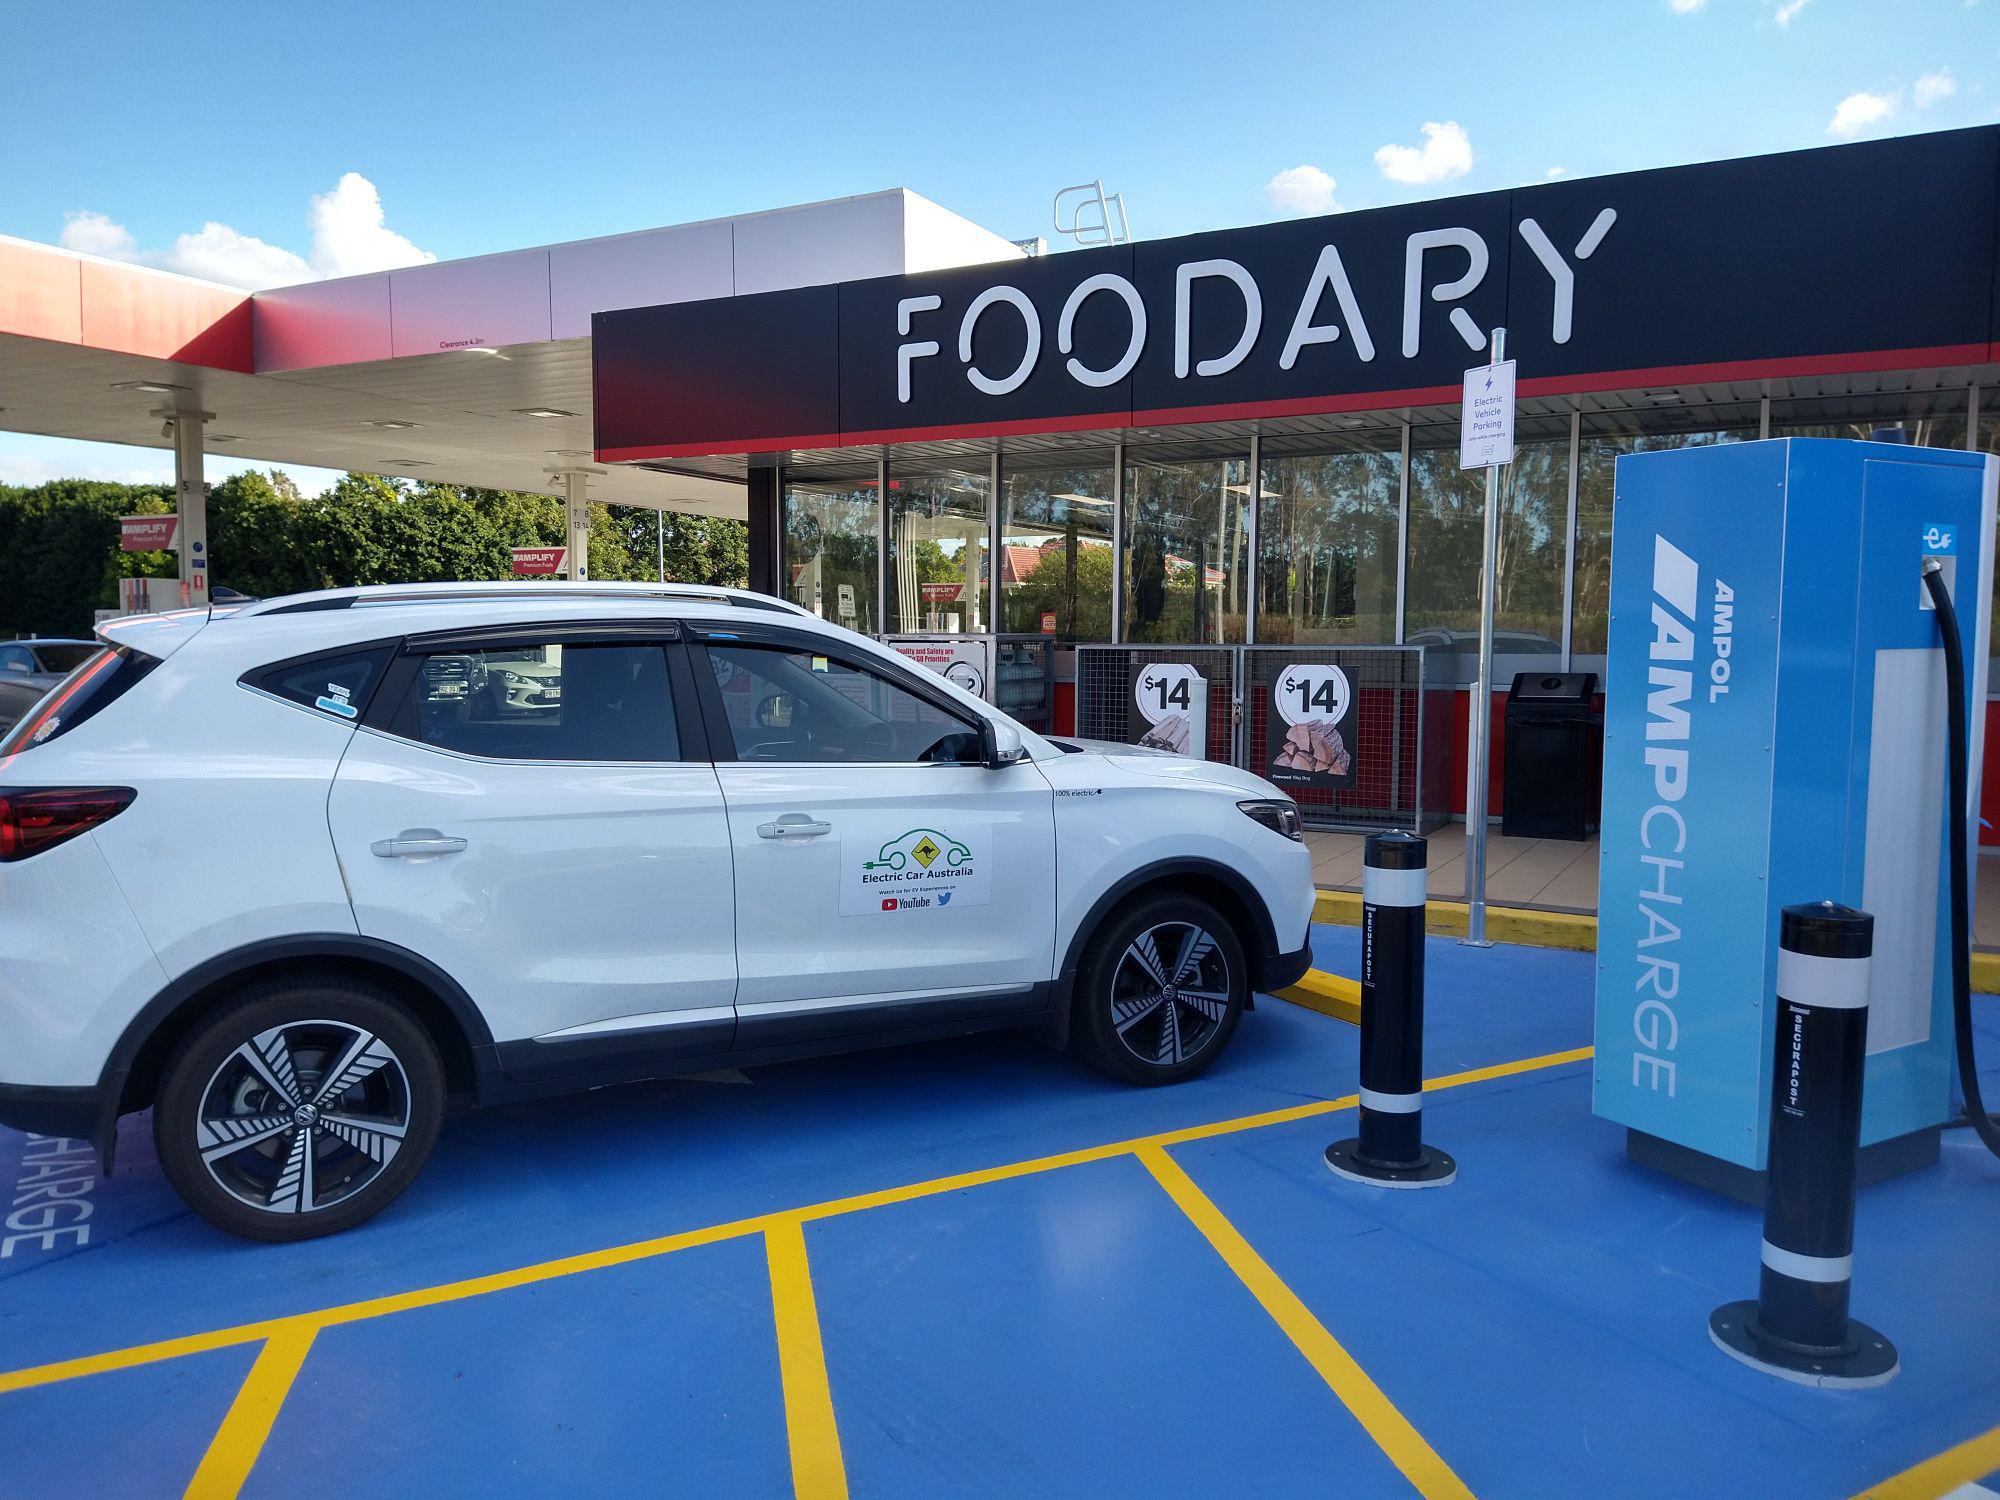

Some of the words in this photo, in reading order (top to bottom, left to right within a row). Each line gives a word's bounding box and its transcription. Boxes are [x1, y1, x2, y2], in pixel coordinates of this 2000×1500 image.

[898, 207, 1618, 403] FOODARY
[440, 340, 468, 348] Clearance
[1474, 395, 1503, 407] Electric
[1474, 408, 1501, 418] Vehicle
[1473, 420, 1502, 431] Parking
[183, 481, 189, 491] 5
[127, 523, 167, 534] AMPLIFY
[517, 553, 555, 562] AMPLIFY
[1709, 578, 1734, 704] AMPOL
[915, 647, 926, 655] and
[926, 647, 944, 656] Safety
[924, 655, 950, 663] Priorities
[1144, 675, 1190, 711] $14
[1285, 677, 1338, 713] $14
[1071, 789, 1094, 797] electric
[1632, 602, 1695, 1099] AMPCHARGE
[862, 872, 903, 884] Electric
[906, 871, 924, 880] Car
[927, 867, 974, 879] Australia
[899, 897, 931, 909] YouTube
[1789, 1014, 1803, 1106] SECURAPOST
[0, 1132, 97, 1258] HARGE
